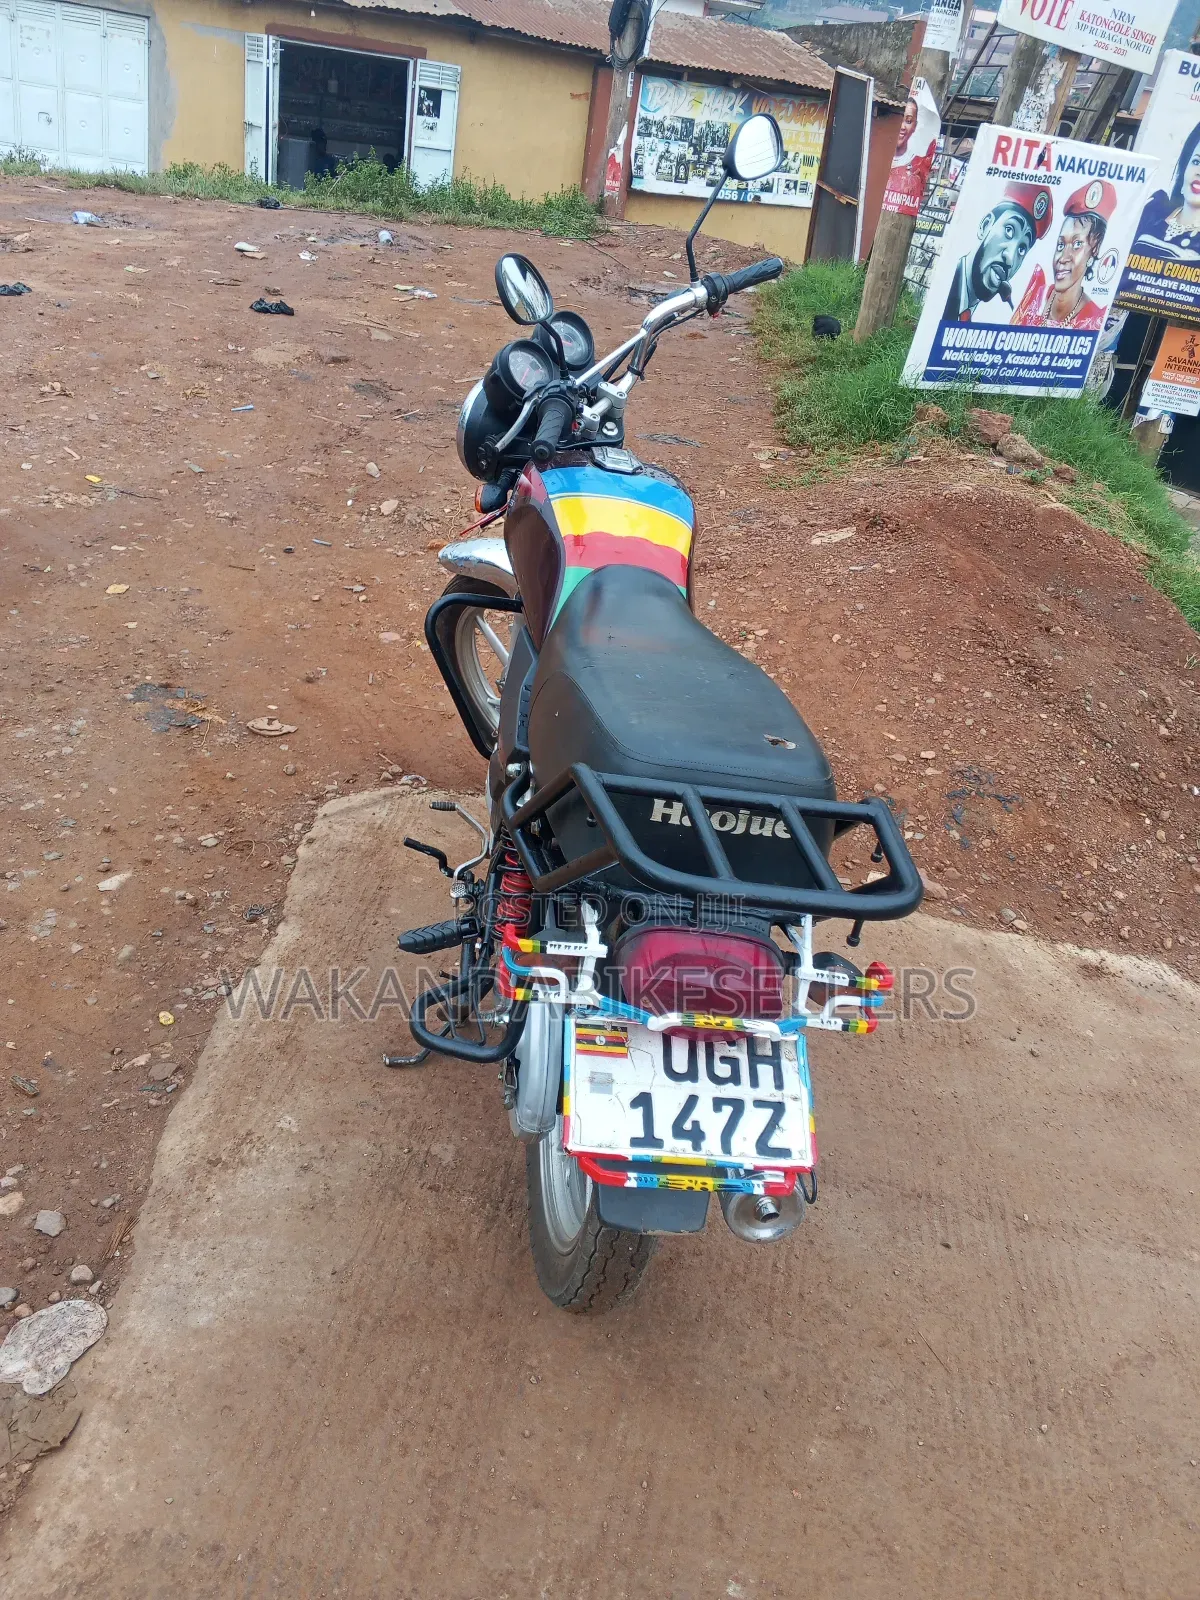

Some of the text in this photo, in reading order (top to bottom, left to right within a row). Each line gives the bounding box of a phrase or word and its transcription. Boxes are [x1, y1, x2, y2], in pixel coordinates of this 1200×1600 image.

[1018, 0, 1075, 31] VOTE
[1110, 8, 1137, 26] NRM
[1075, 21, 1153, 55] MP RUBAGA NORTH
[1079, 10, 1158, 46] KATONGOLE SINGH
[1093, 40, 1110, 51] 2026
[1113, 46, 1128, 57] 2031
[700, 87, 751, 119] MARK
[991, 134, 1147, 184] RITA NAKUBULWA
[985, 166, 1063, 186] #Protestvote2026
[888, 191, 920, 209] KAMPALA
[1128, 271, 1179, 290] NAKULABYE
[1119, 291, 1142, 300] WOMEN
[1147, 297, 1166, 306] YOUTH
[1136, 284, 1195, 303] RUBAGA DIVISION
[941, 327, 1093, 356] WOMAN COUNCILLOR LC5
[1000, 366, 1018, 377] Gali
[1017, 368, 1057, 380] Mubantu
[1005, 353, 1042, 366] Kasubi
[1042, 355, 1051, 366] &
[1051, 356, 1083, 370] Lubya
[650, 798, 793, 839] Hojue
[661, 1033, 785, 1091] UGH
[629, 1091, 793, 1159] 147Z
